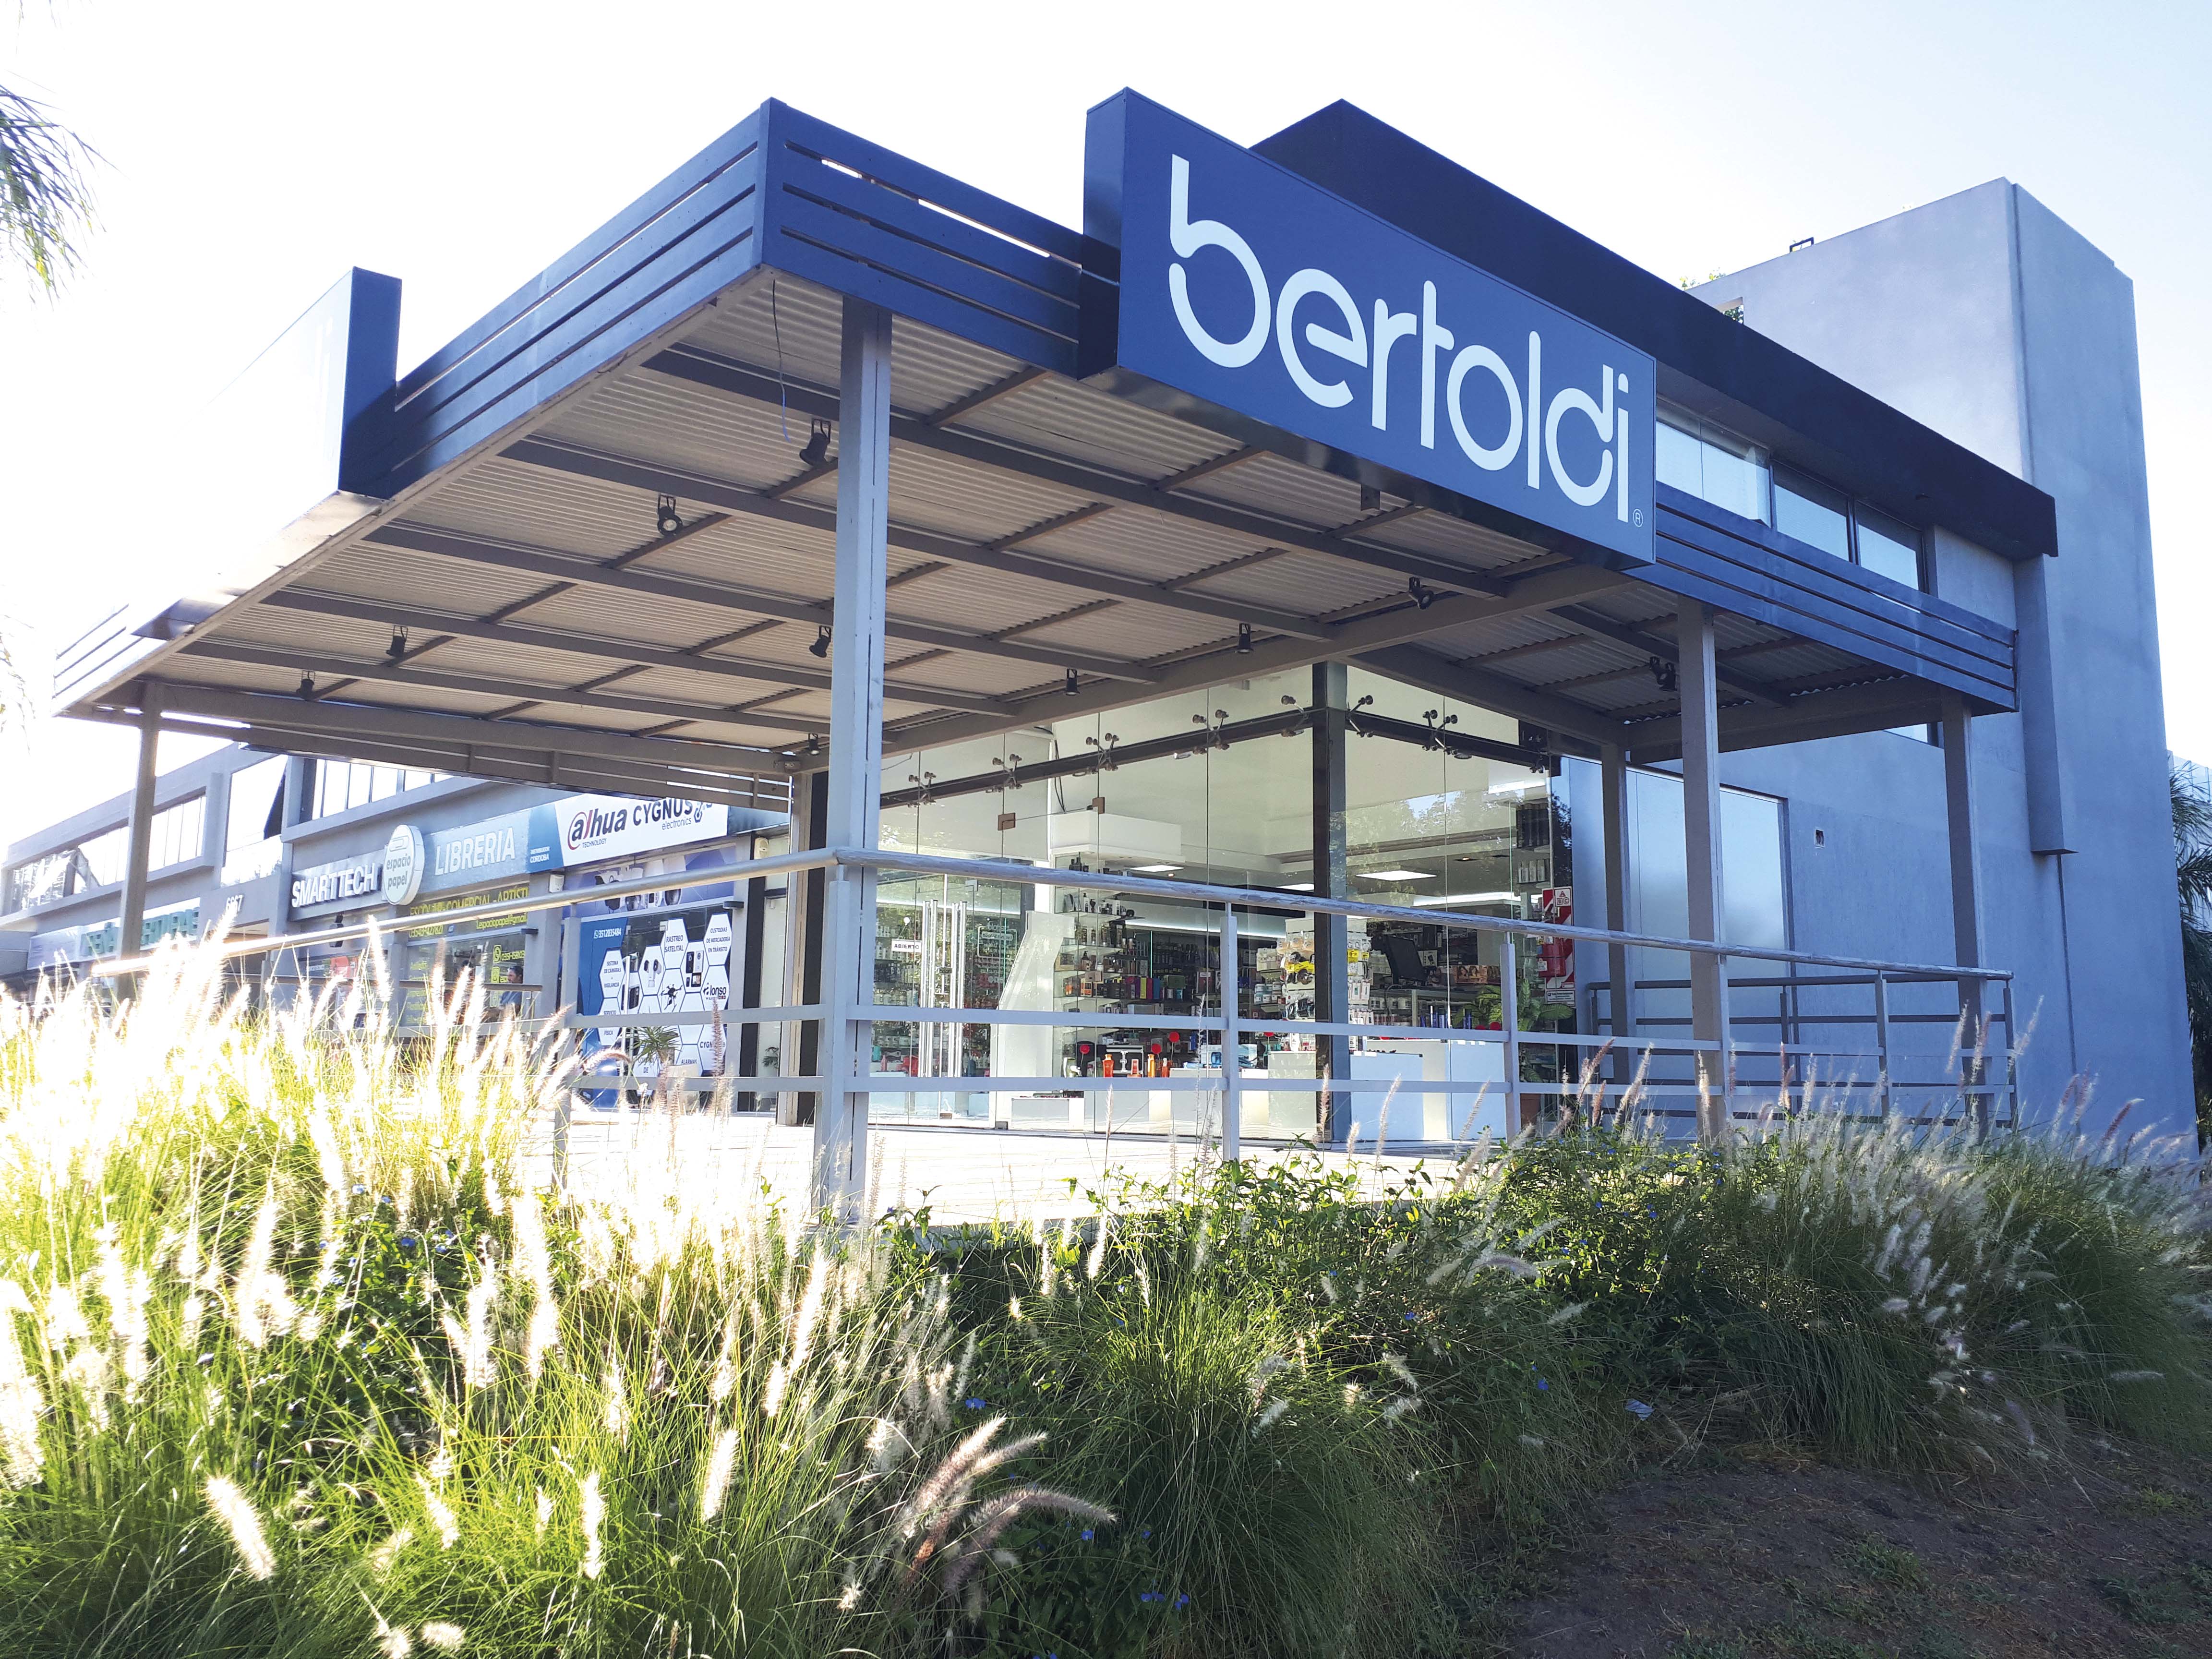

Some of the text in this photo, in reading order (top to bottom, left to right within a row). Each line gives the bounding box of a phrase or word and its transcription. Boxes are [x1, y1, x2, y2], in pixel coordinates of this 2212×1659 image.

[1169, 154, 1629, 522] bertoldi
[633, 798, 693, 826] CYGNUS
[662, 817, 692, 830] electronics
[435, 827, 515, 876] LIBRERIA
[582, 838, 606, 848] TECHNOLOGY
[386, 853, 411, 871] espacio
[291, 863, 377, 907] SMARTTECH
[388, 871, 408, 890] papel
